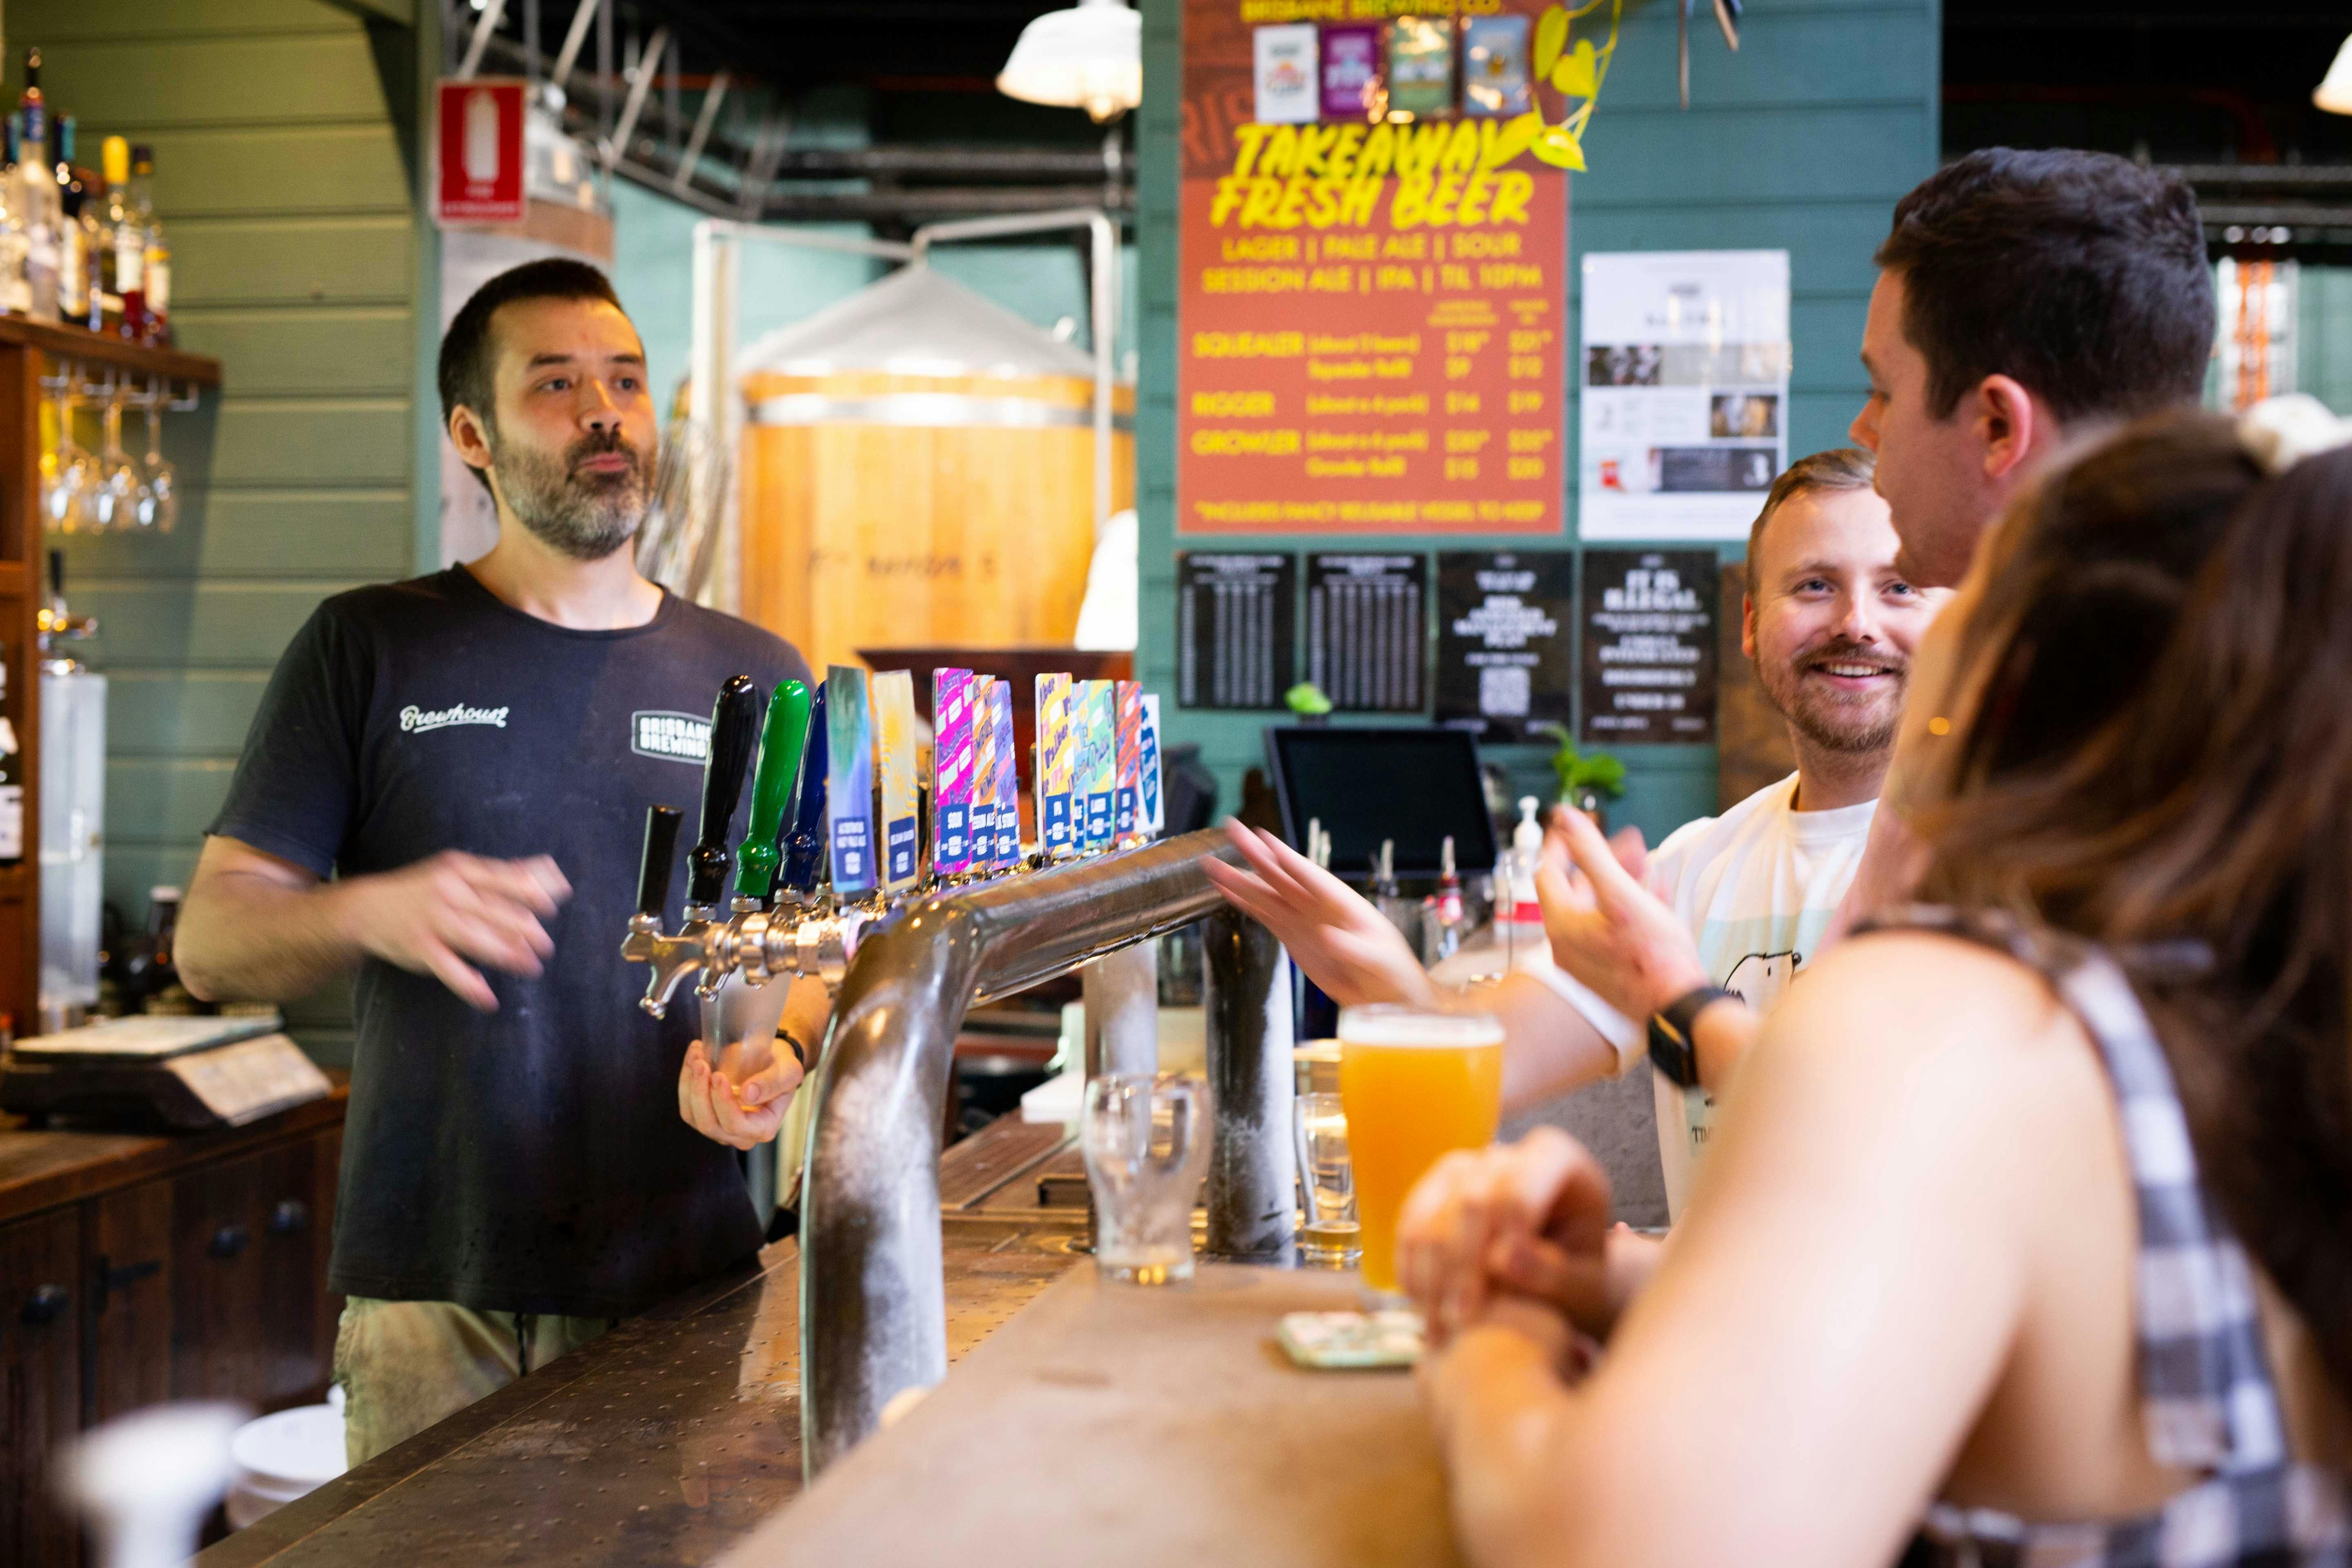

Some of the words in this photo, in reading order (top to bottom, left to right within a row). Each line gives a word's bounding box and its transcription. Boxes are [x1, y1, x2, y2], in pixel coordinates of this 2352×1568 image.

[1209, 174, 1383, 229] FRESH
[1390, 170, 1534, 230] BEER
[1223, 236, 1298, 260] LAGER
[1324, 236, 1376, 258] PALE
[1384, 234, 1424, 257] ALE
[1454, 234, 1519, 256] SOUR
[1203, 267, 1305, 292] SESSION
[1309, 267, 1350, 291] ALE
[640, 733, 707, 757] BREWING
